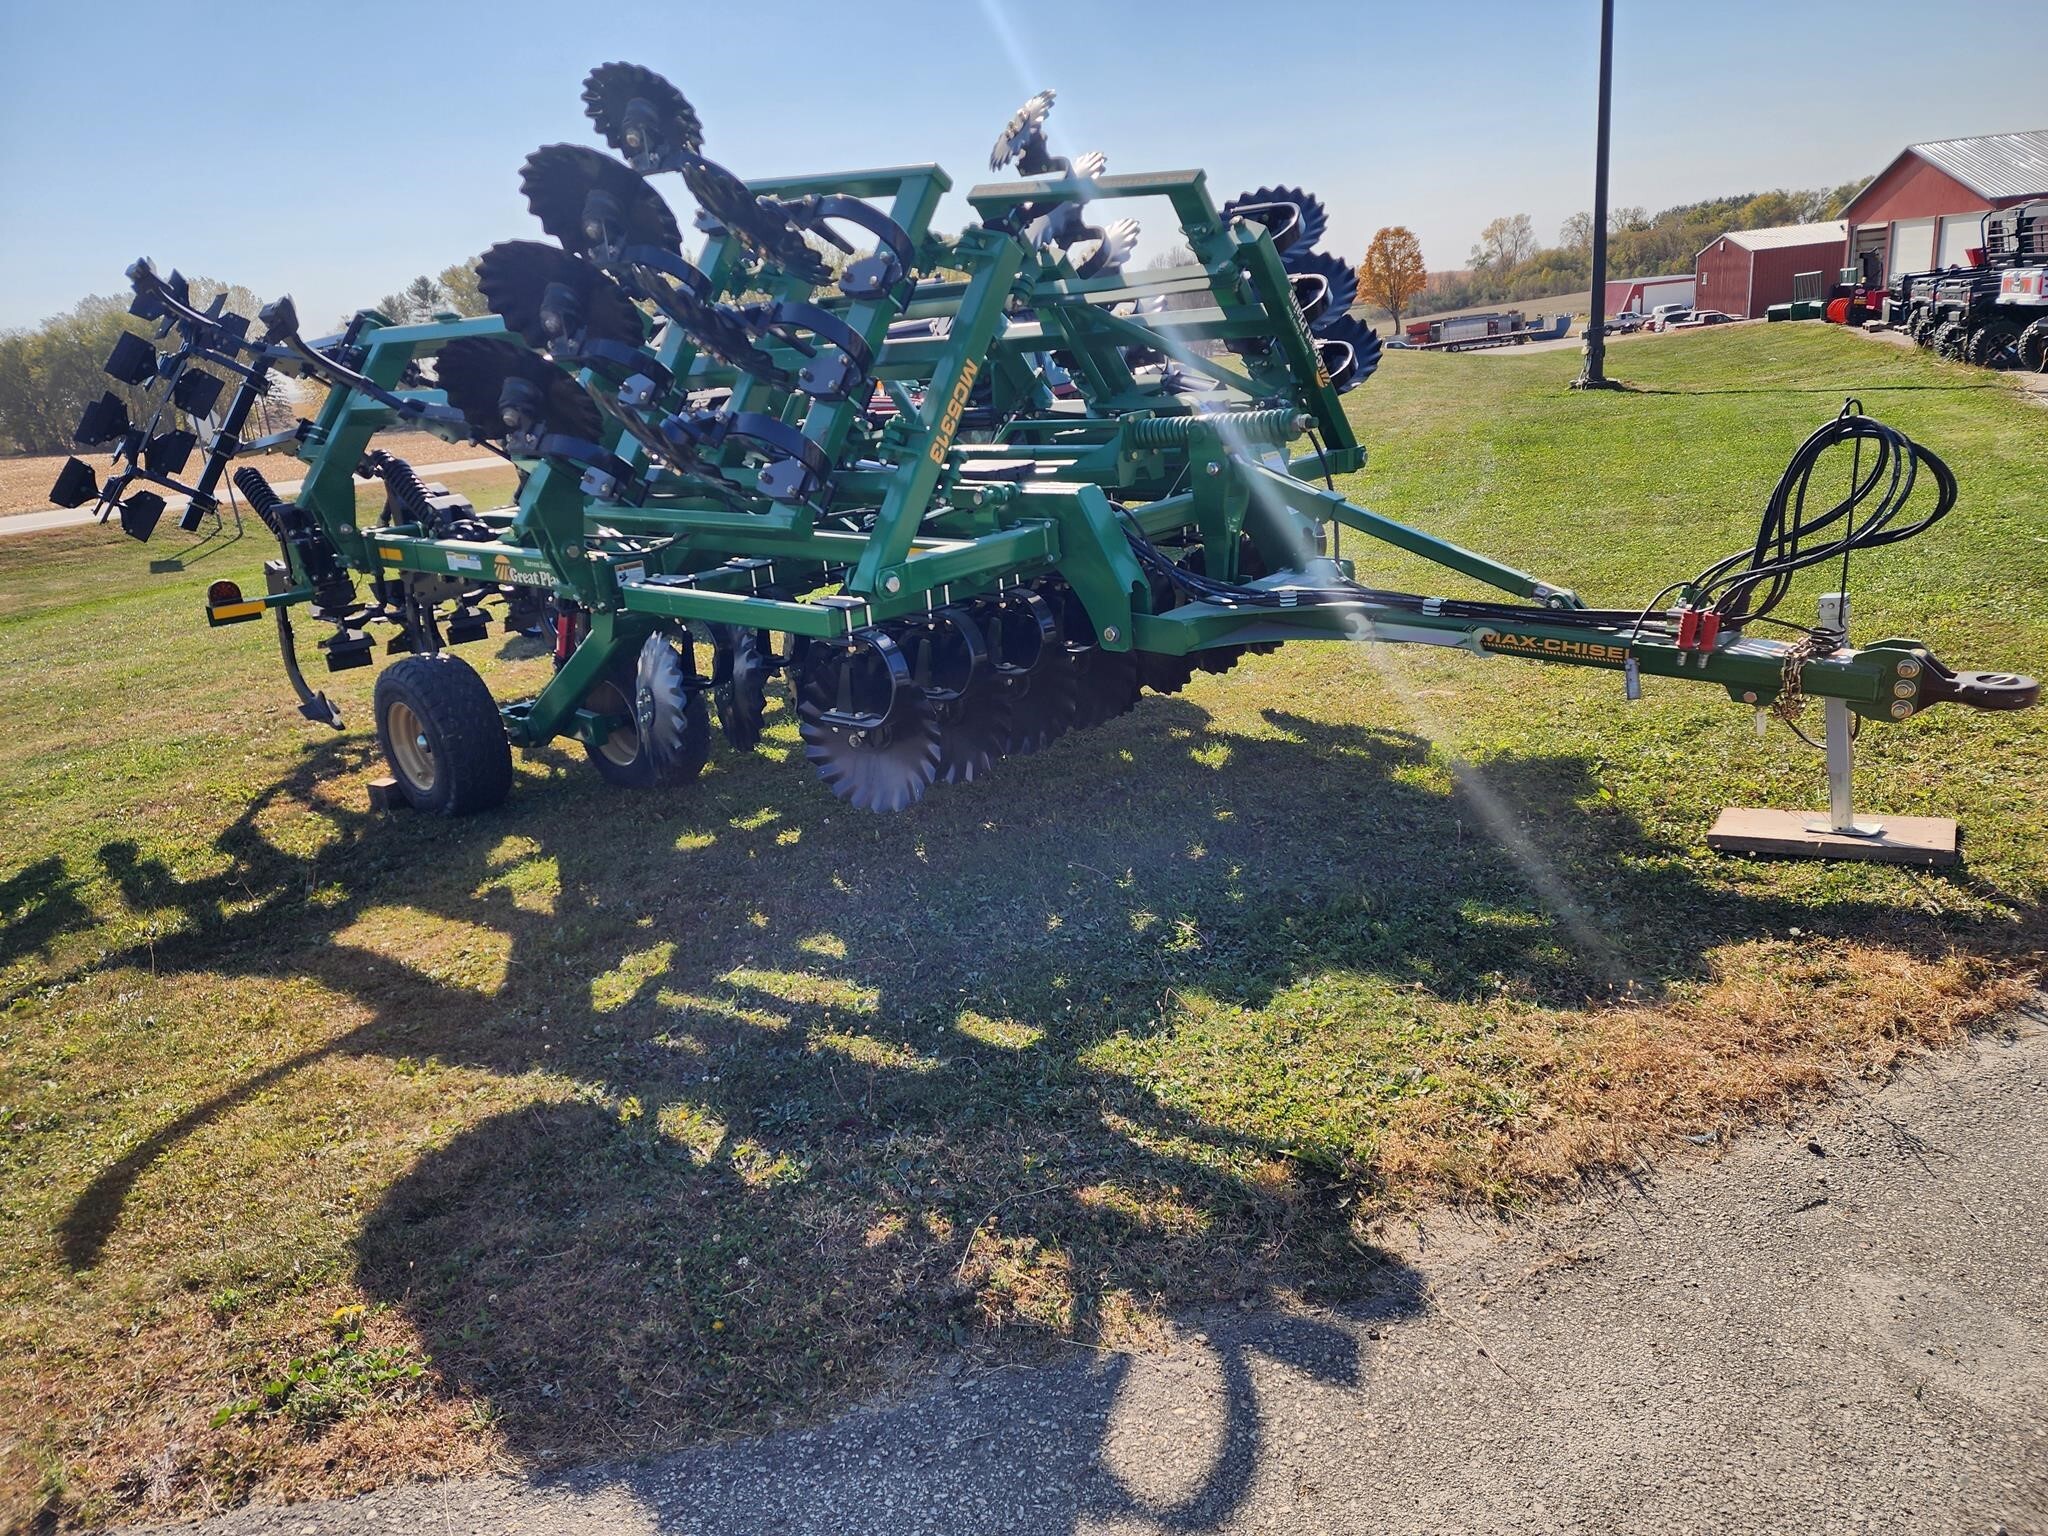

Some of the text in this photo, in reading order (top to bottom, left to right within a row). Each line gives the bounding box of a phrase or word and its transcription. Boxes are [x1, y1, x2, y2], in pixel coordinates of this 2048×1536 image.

[929, 358, 978, 464] MC5313
[509, 567, 559, 587] Great Pla
